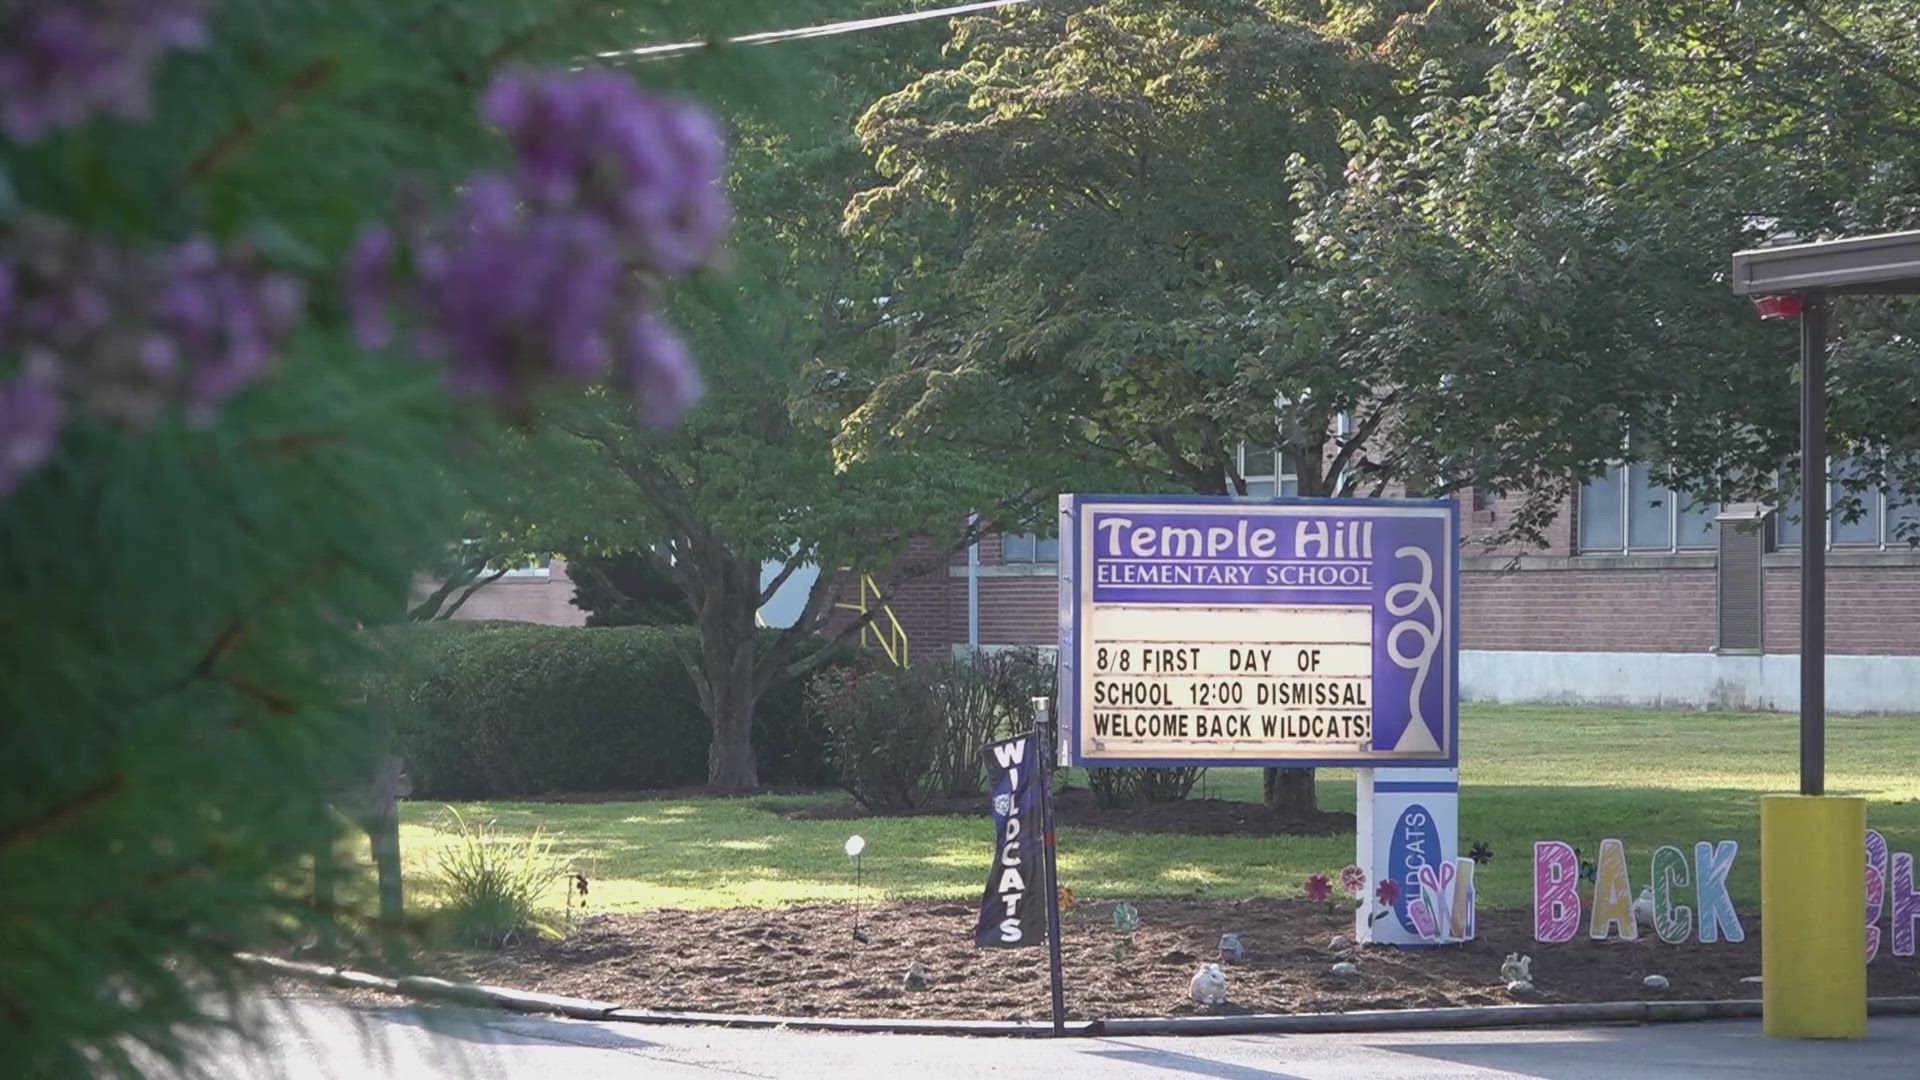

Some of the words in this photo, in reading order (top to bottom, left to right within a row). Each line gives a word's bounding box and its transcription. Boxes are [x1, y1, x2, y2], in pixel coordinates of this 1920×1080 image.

[1098, 517, 1277, 558] Temple
[1295, 521, 1373, 558] Hill
[1097, 564, 1254, 584] ELEMENTARY
[1266, 566, 1373, 585] SCHOOL
[1097, 647, 1130, 672] 8/8
[1143, 648, 1200, 672] FIRST
[1229, 649, 1272, 671] DAY
[1297, 649, 1321, 672] OF
[1094, 681, 1173, 705] SCHOOL
[1190, 682, 1242, 706] 12:00
[1257, 682, 1366, 705] DISMISSAL
[1093, 713, 1189, 737] WELCOME
[1196, 714, 1251, 737] BACK
[1261, 714, 1370, 738] WILDCATS!
[994, 739, 1026, 943] WILDCATS
[1534, 838, 1745, 944] BACK
